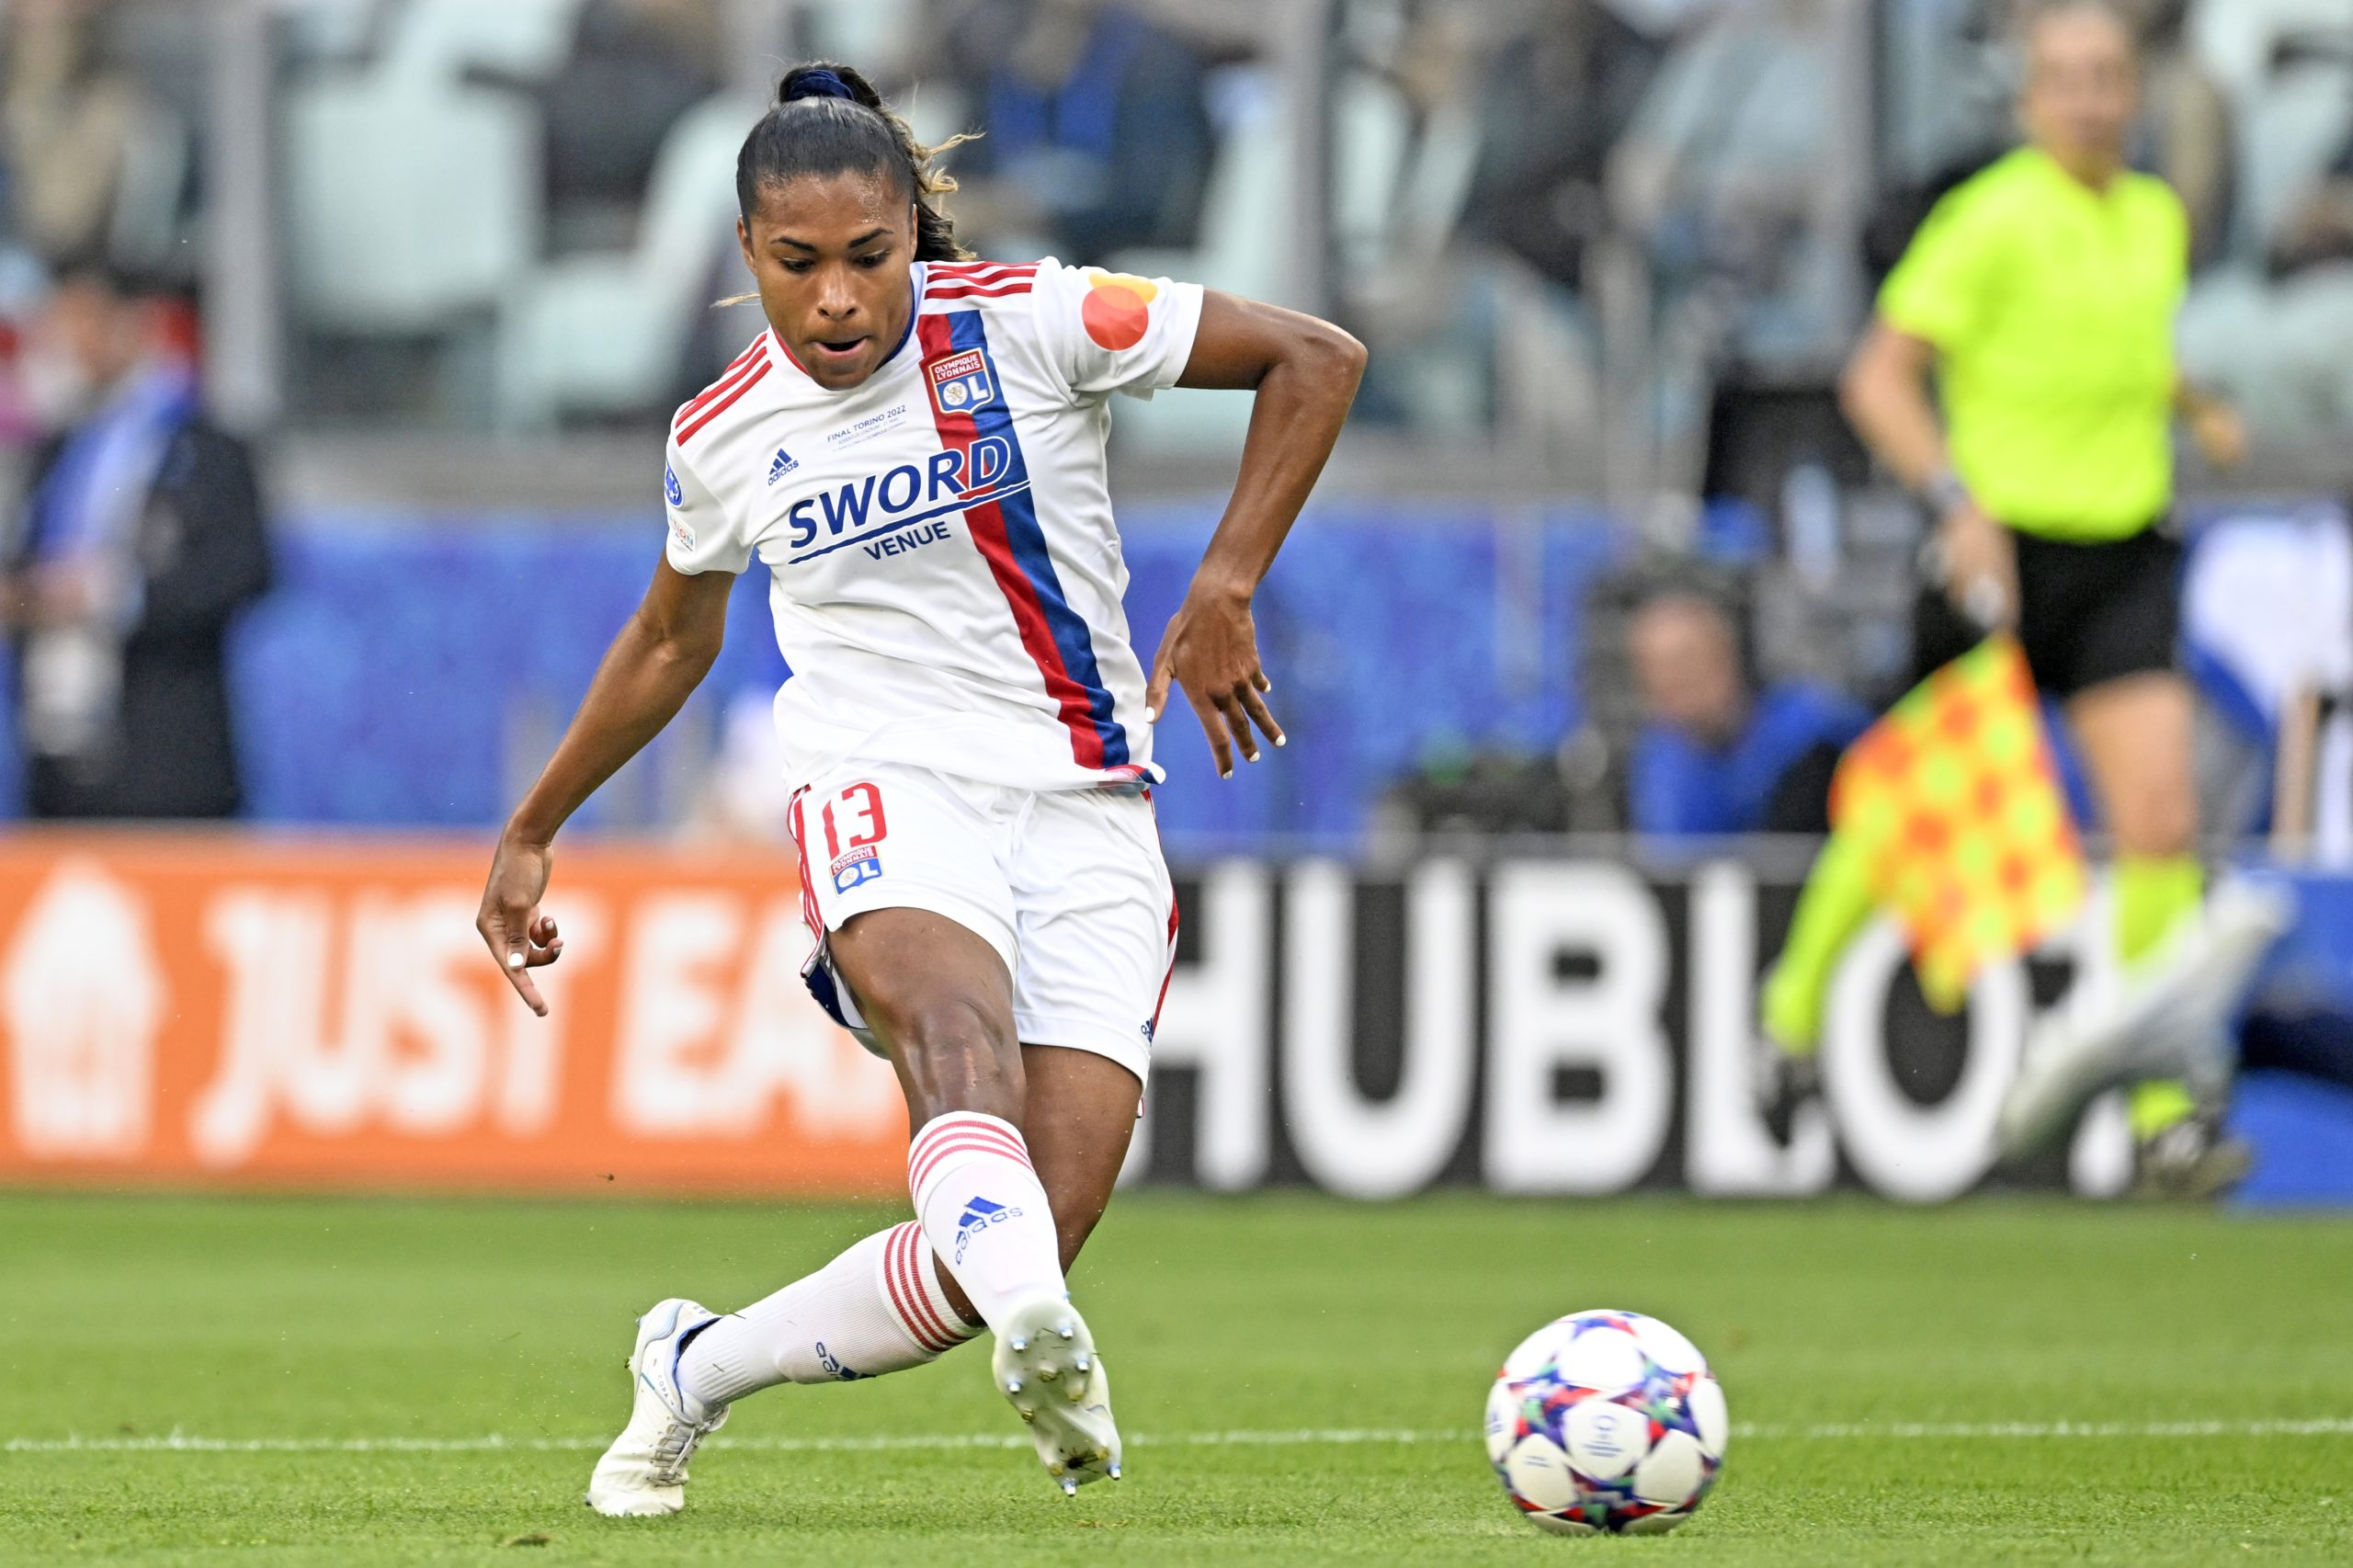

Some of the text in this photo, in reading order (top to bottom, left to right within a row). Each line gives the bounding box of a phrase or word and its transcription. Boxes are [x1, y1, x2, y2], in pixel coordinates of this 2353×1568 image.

[935, 354, 979, 374] OLYMPIQUE
[937, 361, 981, 381] LYONNAIS
[827, 428, 851, 442] FINAL
[853, 414, 885, 431] TORINO
[887, 404, 906, 418] 2022
[767, 460, 800, 486] adidas
[788, 436, 1010, 549] SWORD
[863, 521, 951, 561] VENUE
[822, 782, 888, 861] 13
[188, 878, 908, 1169] JUST EA
[956, 1207, 1023, 1265] adidas
